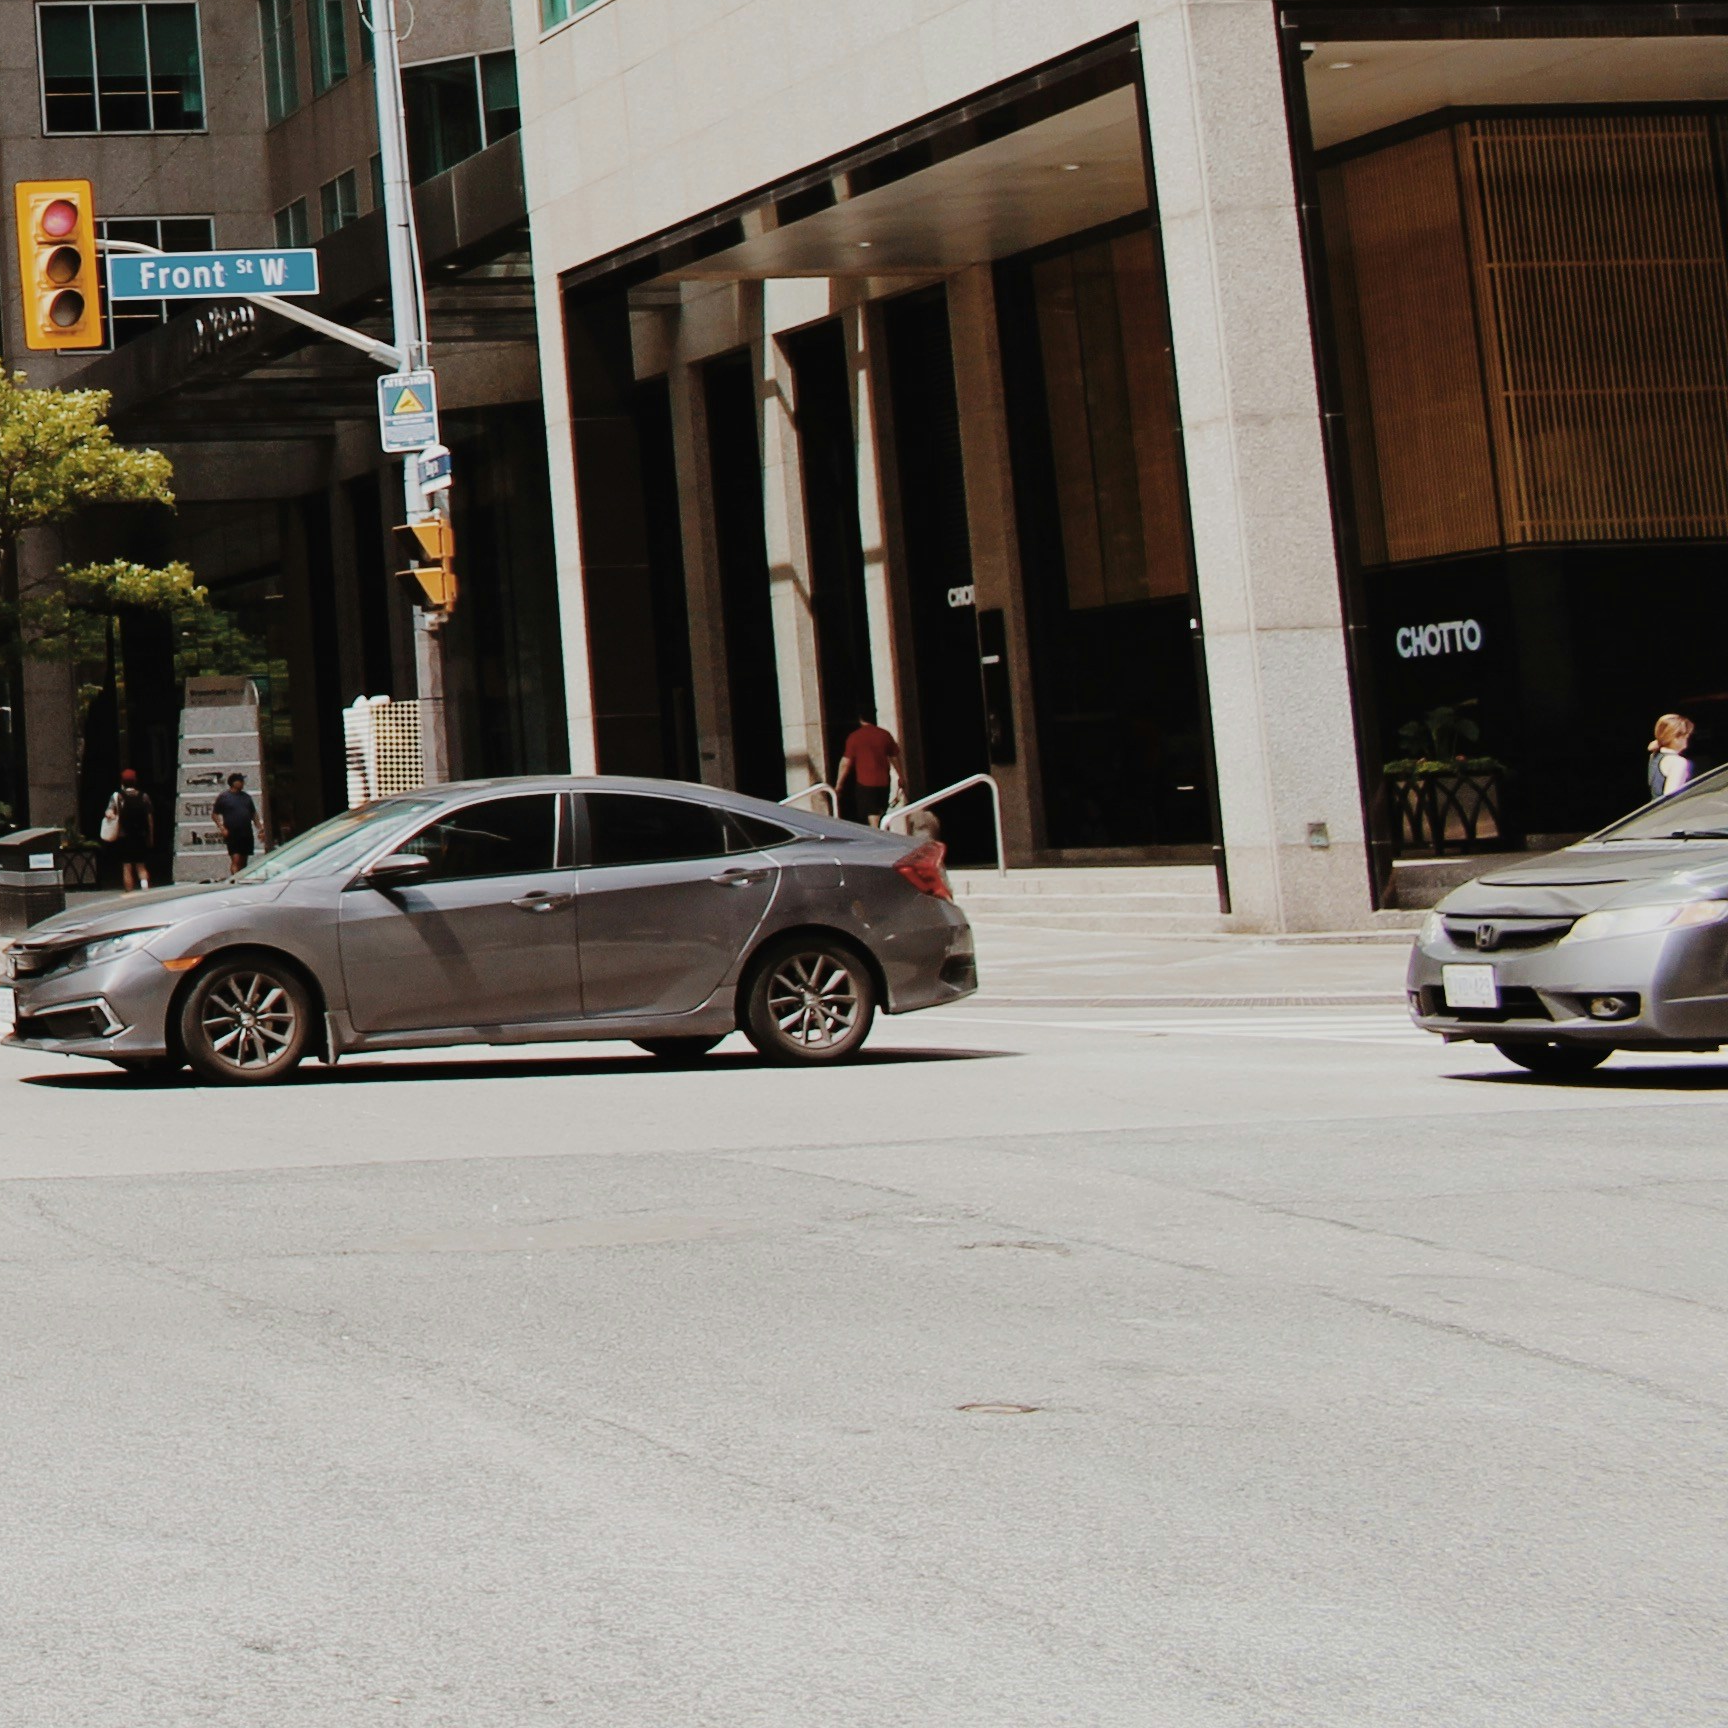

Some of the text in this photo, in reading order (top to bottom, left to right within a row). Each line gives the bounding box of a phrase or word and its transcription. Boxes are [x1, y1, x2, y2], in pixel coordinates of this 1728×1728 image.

[140, 257, 286, 289] Front St W
[947, 584, 975, 608] CHO
[1396, 618, 1482, 658] CHOTTO
